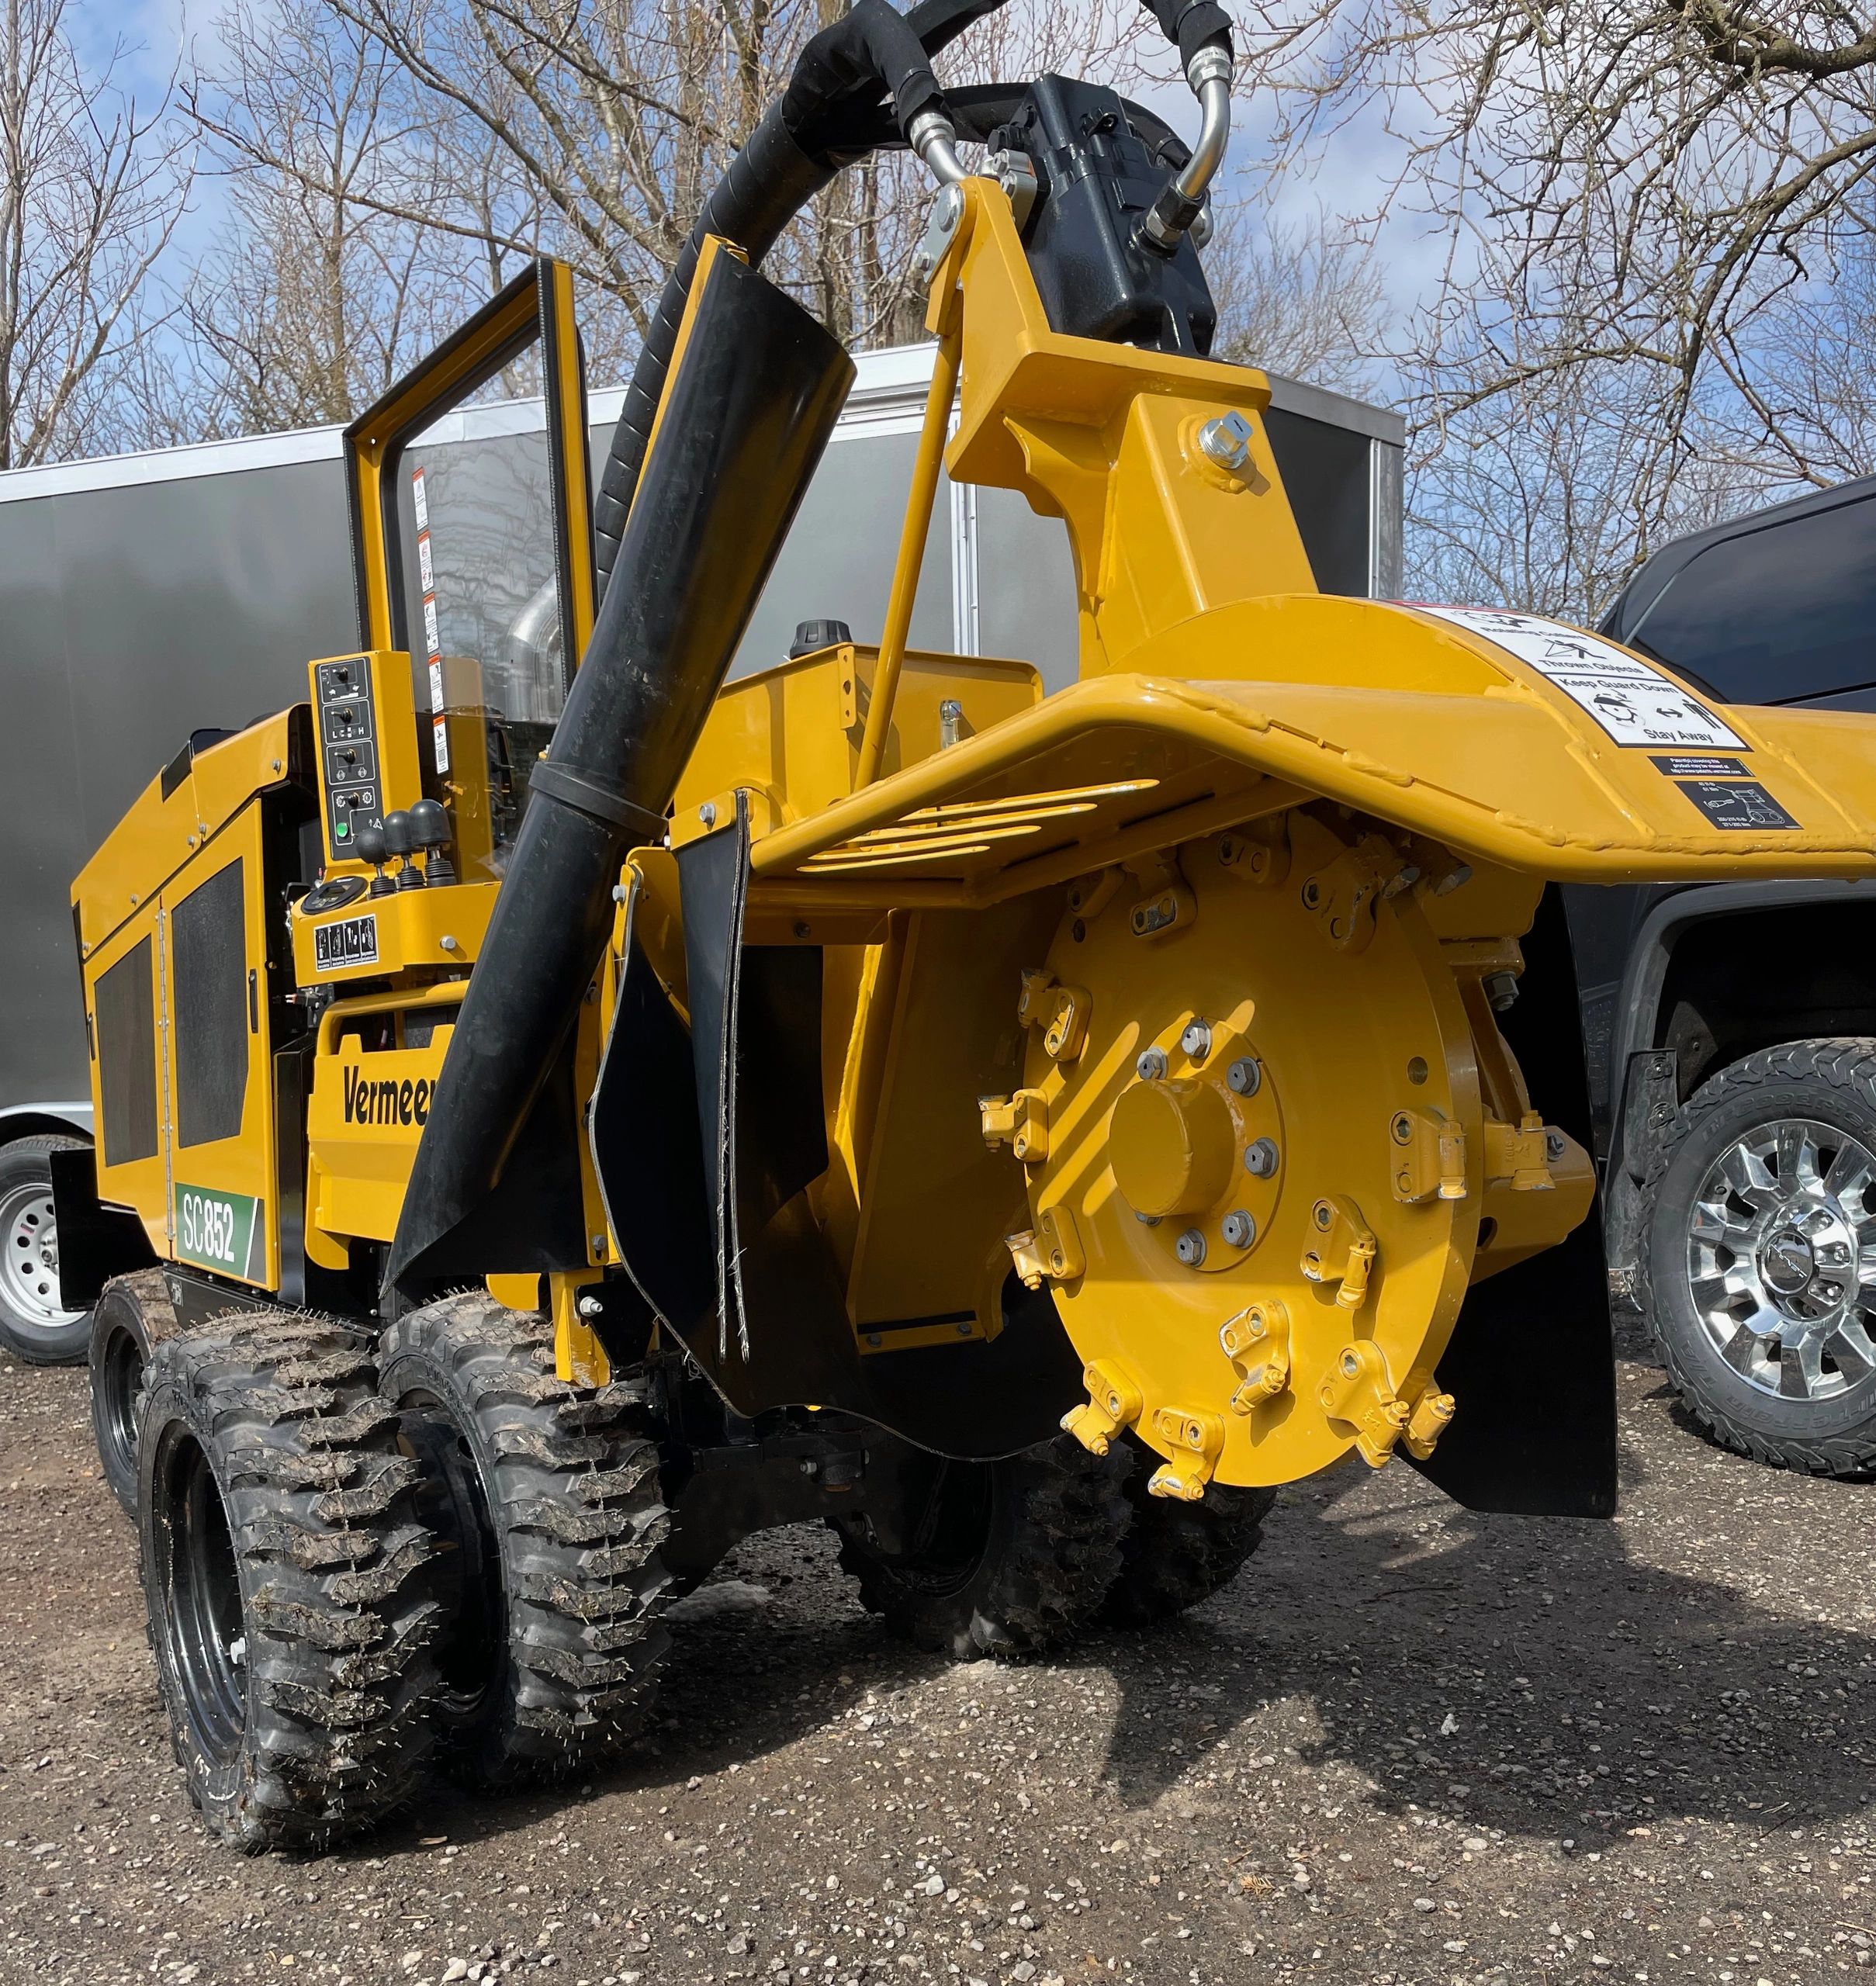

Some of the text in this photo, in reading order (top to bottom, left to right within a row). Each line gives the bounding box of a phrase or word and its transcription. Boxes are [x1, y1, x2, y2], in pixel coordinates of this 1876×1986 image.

[1539, 659, 1644, 674] Thrown Objects
[1559, 678, 1680, 694] Keep Guard Down
[1643, 728, 1714, 743] Stay Away
[183, 1192, 235, 1263] SC852
